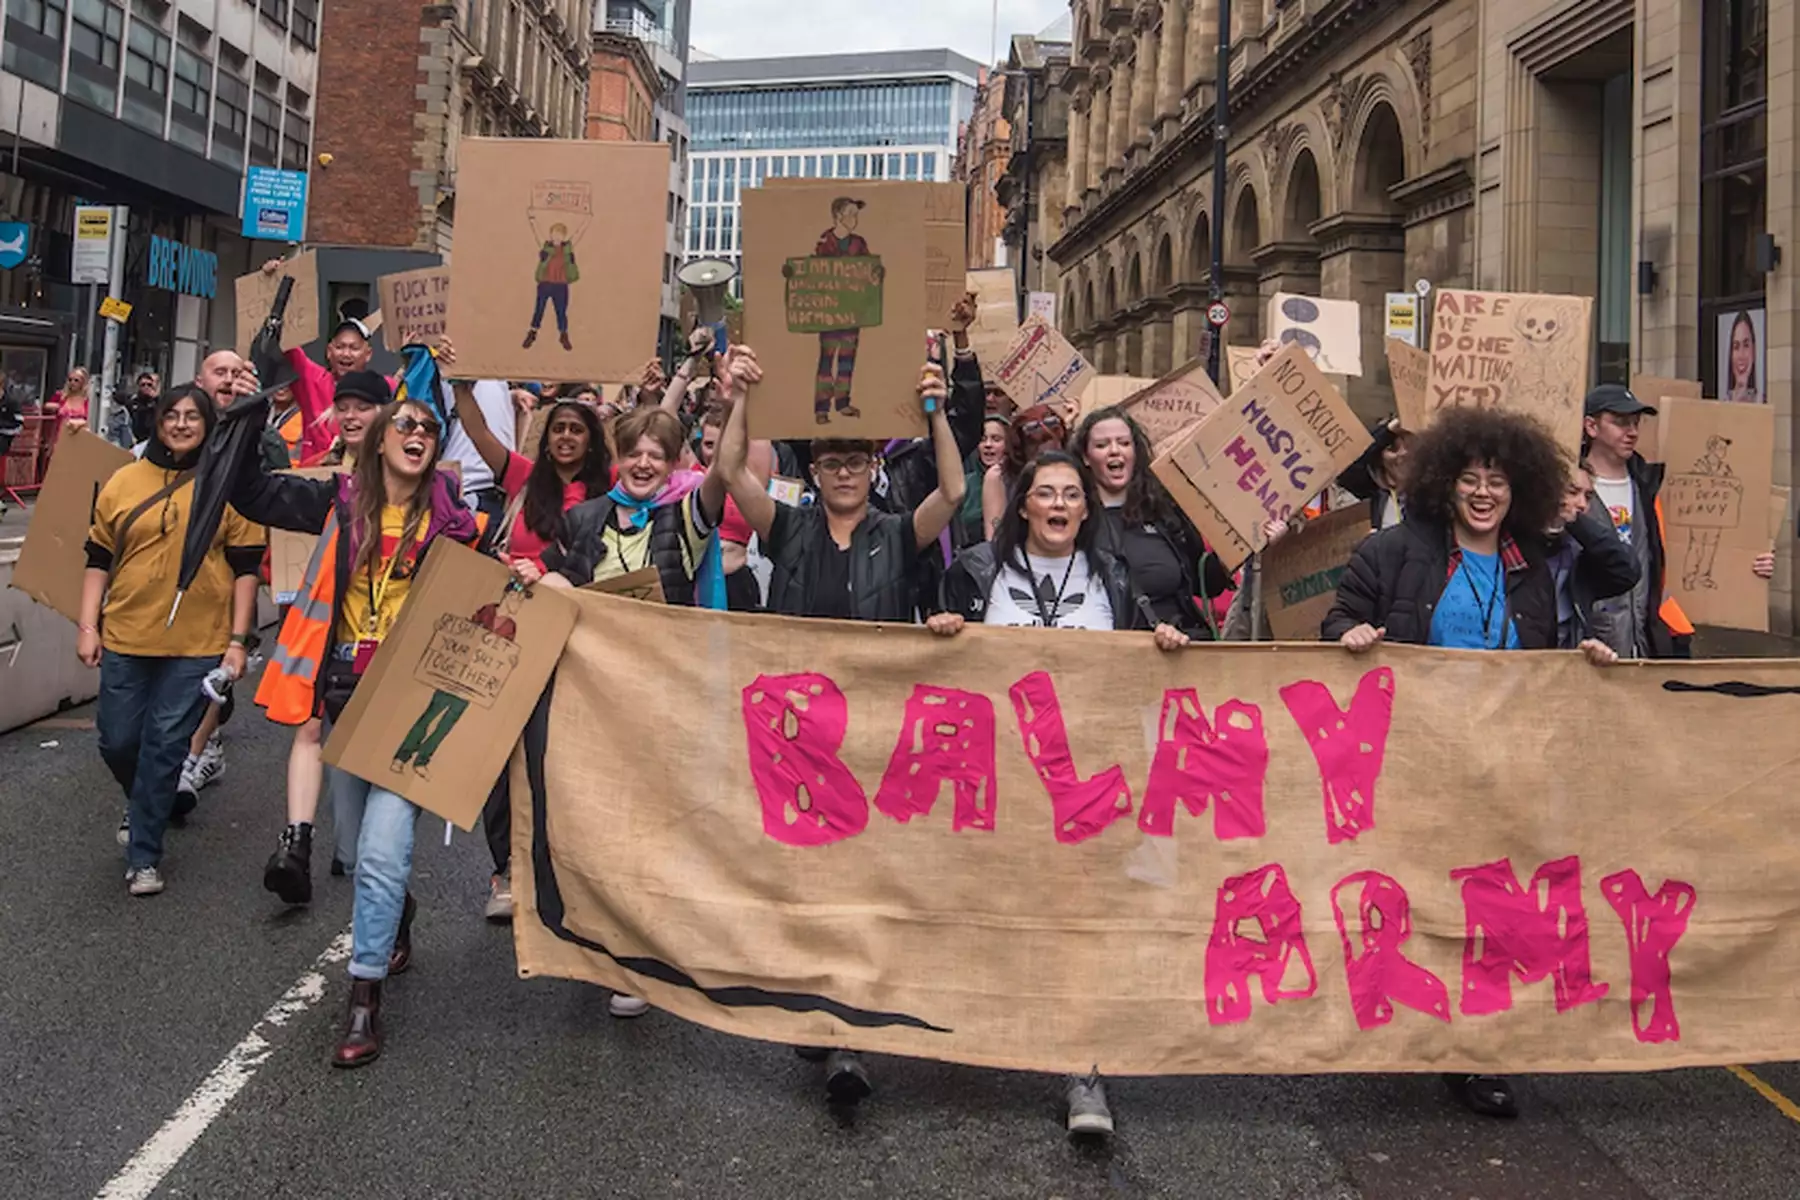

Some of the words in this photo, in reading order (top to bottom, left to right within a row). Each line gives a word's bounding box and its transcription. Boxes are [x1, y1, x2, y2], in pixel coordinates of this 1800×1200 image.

[393, 279, 427, 303] FUCK
[1212, 309, 1225, 319] 20
[1437, 292, 1511, 316] ARE
[1438, 315, 1478, 332] WE
[1435, 332, 1515, 354] DONE
[1431, 354, 1513, 382] WAITING
[1144, 398, 1207, 416] MENTAL
[1272, 358, 1306, 396] NO
[1295, 389, 1355, 459] EXCUSE
[1241, 398, 1314, 490] MUSIC
[1224, 435, 1292, 522] HEALS
[482, 631, 512, 652] GET
[742, 666, 1395, 846] BALMY
[1203, 855, 1696, 1043] ARMY
